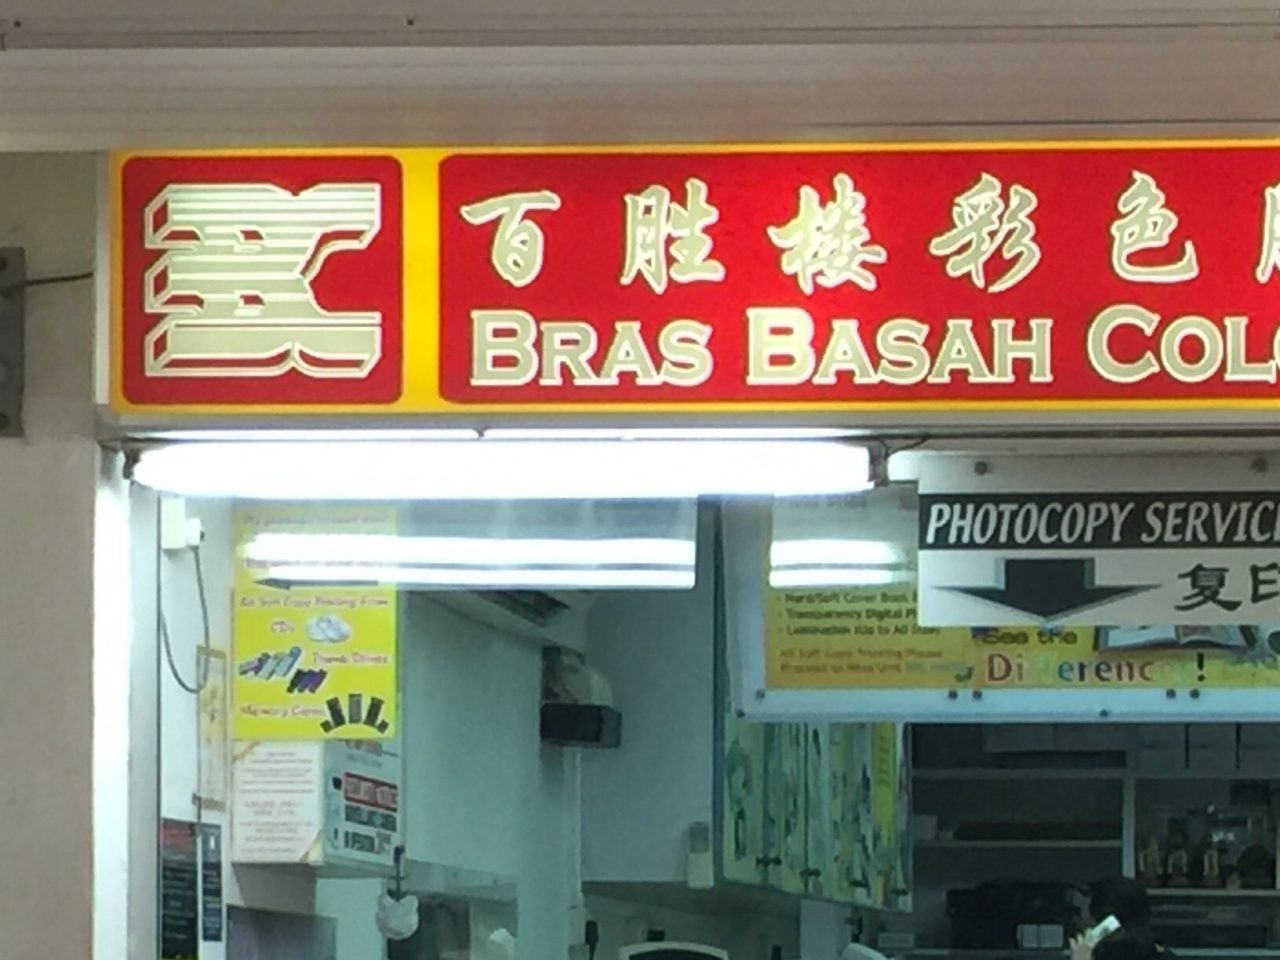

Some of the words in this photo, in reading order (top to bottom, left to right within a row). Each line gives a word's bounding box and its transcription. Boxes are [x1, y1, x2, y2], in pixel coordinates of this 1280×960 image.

[469, 308, 714, 388] BRAS
[745, 305, 1054, 386] BASAH
[925, 501, 1128, 545] PHOTOCOPY
